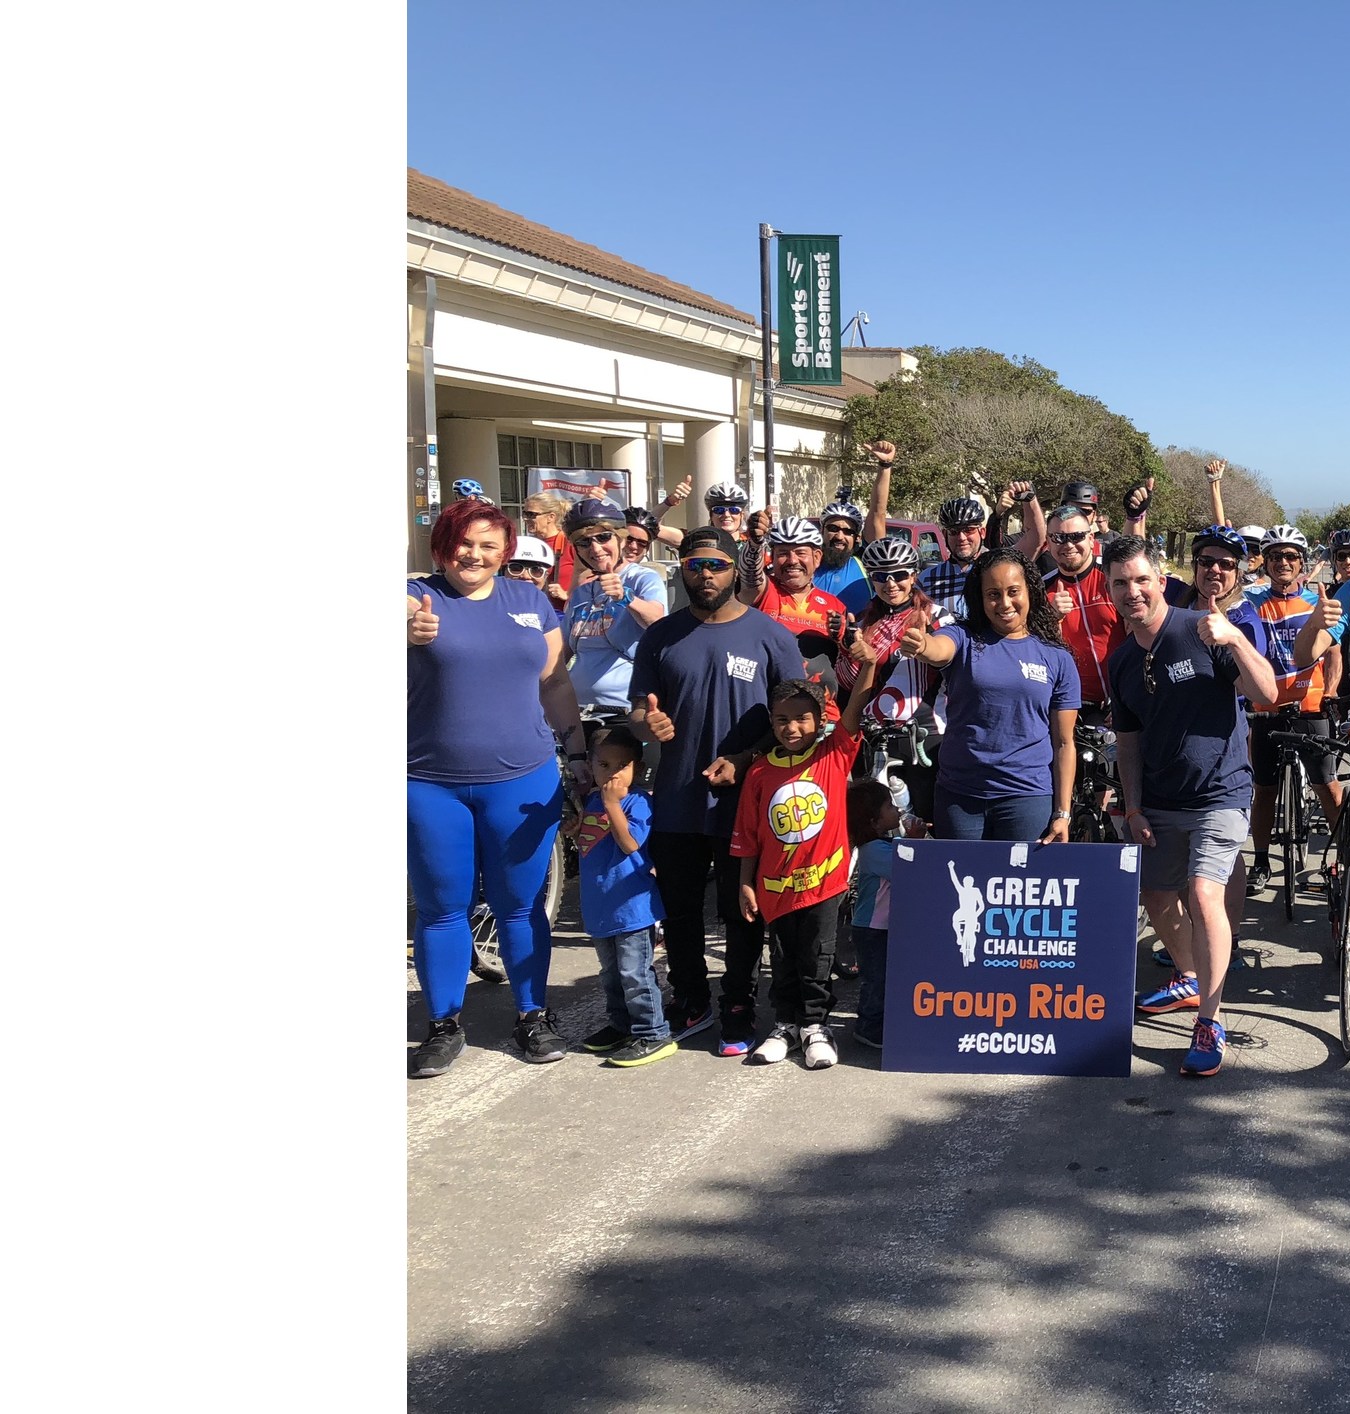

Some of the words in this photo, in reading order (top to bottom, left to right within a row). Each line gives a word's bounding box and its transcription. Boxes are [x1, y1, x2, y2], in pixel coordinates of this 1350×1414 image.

[813, 252, 832, 368] Basement
[791, 289, 813, 368] Sports
[1172, 658, 1191, 670] GREAT
[1174, 664, 1195, 676] CYCLE
[771, 792, 826, 836] GCC
[986, 877, 1080, 906] GREAT
[985, 908, 1078, 937] CYCLE
[984, 939, 1077, 956] CHALLENGE
[1019, 958, 1039, 970] USA
[913, 981, 1017, 1028] Group
[1028, 983, 1106, 1021] Ride
[957, 1032, 1057, 1055] #GCCUSA
